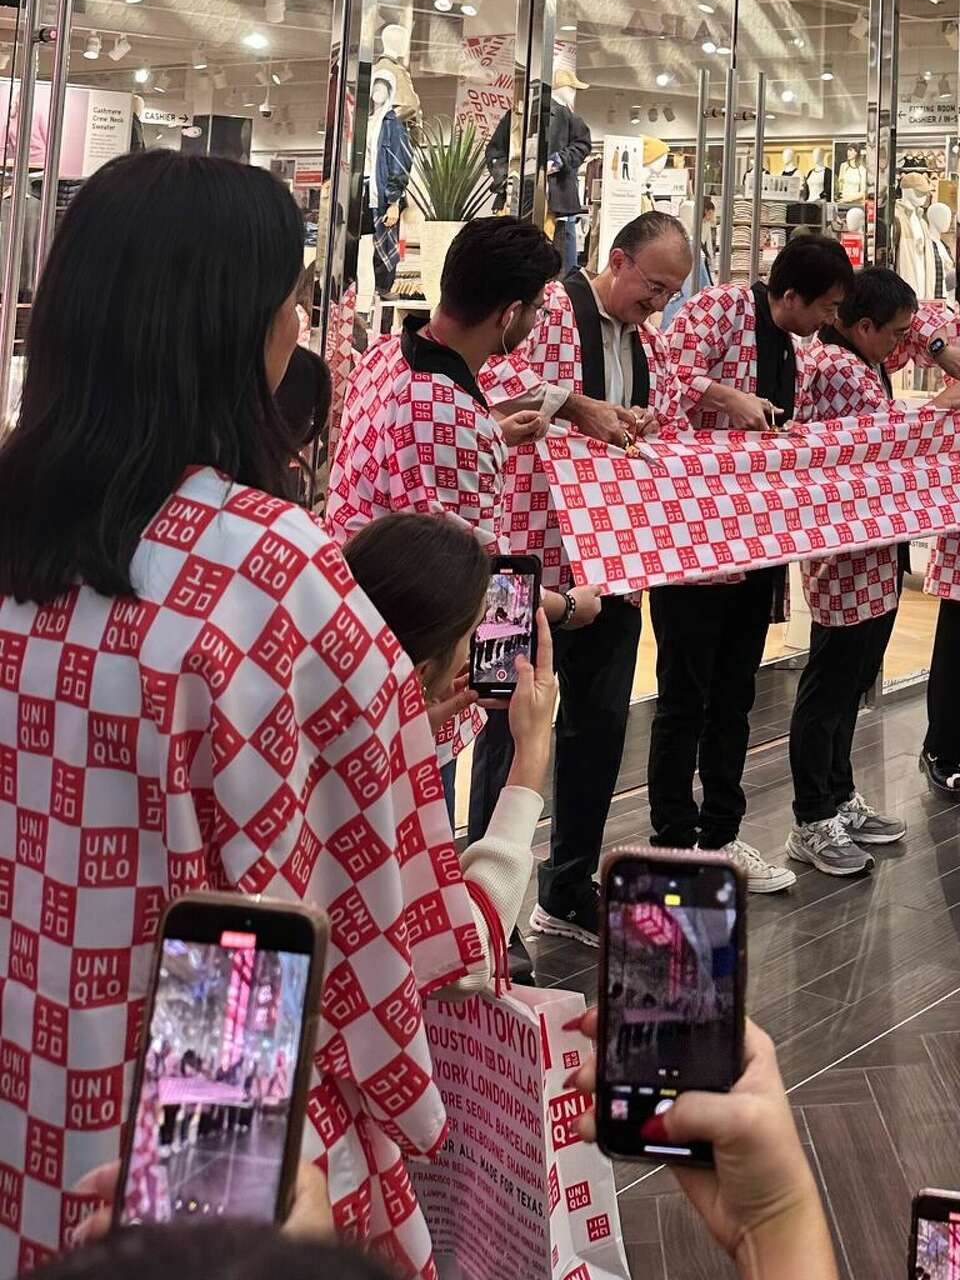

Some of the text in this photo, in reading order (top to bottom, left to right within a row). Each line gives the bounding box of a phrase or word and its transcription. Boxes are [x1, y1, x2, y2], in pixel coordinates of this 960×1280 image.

[145, 112, 176, 121] CASHIER
[168, 502, 205, 523] UNI
[155, 520, 195, 543] QLO
[262, 537, 298, 569] UNI
[249, 555, 288, 589] QLO
[36, 611, 65, 634] QLO
[114, 604, 146, 626] UNI
[106, 627, 139, 650] QLO
[337, 612, 361, 650] UNI
[200, 632, 235, 668] UNI
[321, 630, 354, 670] QLO
[189, 654, 226, 688] QLO
[22, 702, 47, 725] UNI
[20, 725, 49, 748] QLO
[93, 720, 127, 742] UNI
[94, 744, 131, 766] QLO
[417, 764, 438, 798] QLO
[20, 816, 43, 840] UNI
[19, 840, 43, 863] QLO
[86, 835, 127, 856] UNI
[84, 860, 130, 884] QLO
[170, 858, 206, 880] UNI
[440, 848, 461, 881] QLO
[330, 907, 360, 946] QLO
[346, 895, 374, 934] UNI
[77, 957, 118, 976] UNI
[75, 980, 121, 1005] QLO
[482, 999, 537, 1067] TOKYO
[72, 1077, 112, 1099] UNI
[497, 1053, 539, 1103] DALLAS
[435, 1058, 468, 1085] YORK
[471, 1071, 513, 1117] LONDON
[515, 1100, 541, 1138] PARIS
[551, 1096, 586, 1120] UNI
[71, 1100, 115, 1127] QLO
[463, 1122, 504, 1163] MELBOURNE
[466, 1099, 493, 1128] SEOUL
[496, 1117, 544, 1167] BARCELONA
[459, 1143, 477, 1165] ALL
[480, 1155, 498, 1184] MADE
[500, 1175, 514, 1195] FOR
[516, 1187, 546, 1220] TEXAS.
[568, 1186, 586, 1199] UNI
[569, 1195, 588, 1209] QLO
